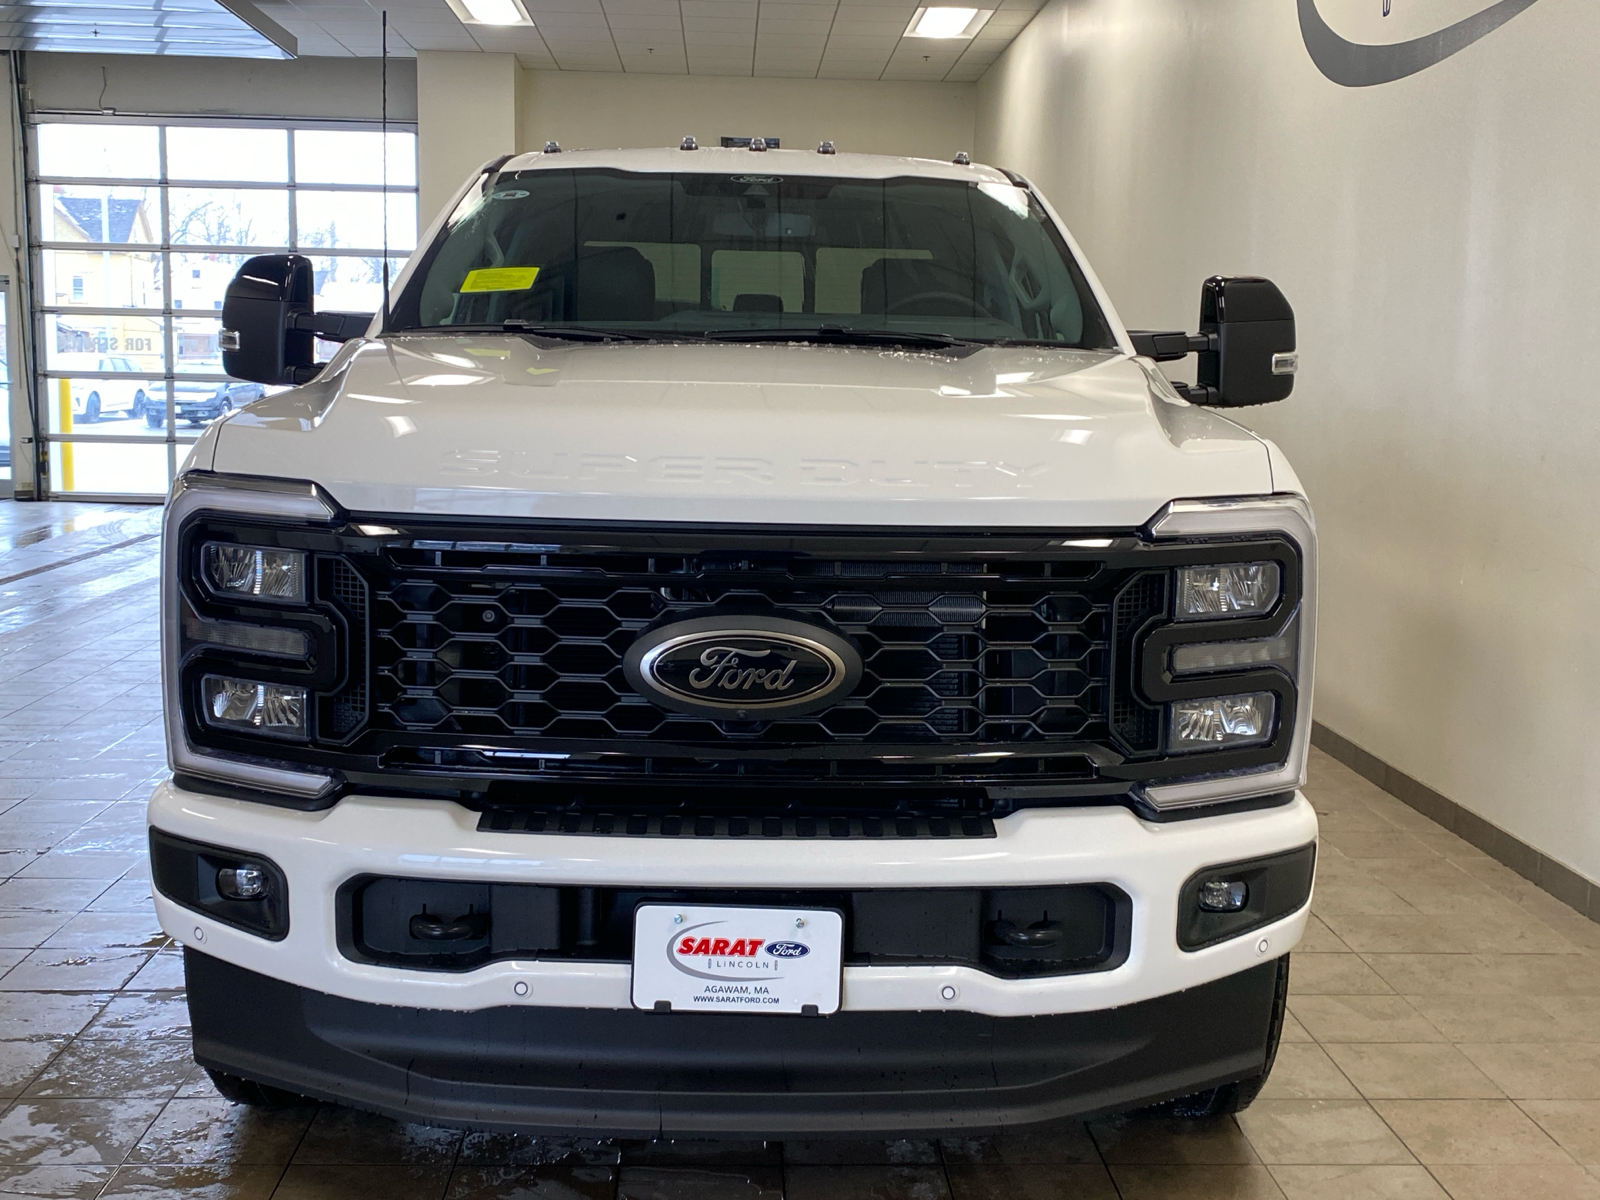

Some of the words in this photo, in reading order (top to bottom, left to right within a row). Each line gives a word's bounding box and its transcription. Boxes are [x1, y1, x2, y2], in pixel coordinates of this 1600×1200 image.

[440, 450, 775, 483] SUPER
[799, 458, 1050, 489] DUTY
[689, 646, 798, 691] Ford
[677, 937, 766, 957] SARAT
[773, 943, 802, 956] Ford
[717, 960, 769, 969] LINCOLN
[704, 985, 751, 995] AGAWAM,
[754, 986, 770, 995] MA
[693, 995, 780, 1005] WWW.SARATFORD.COM
